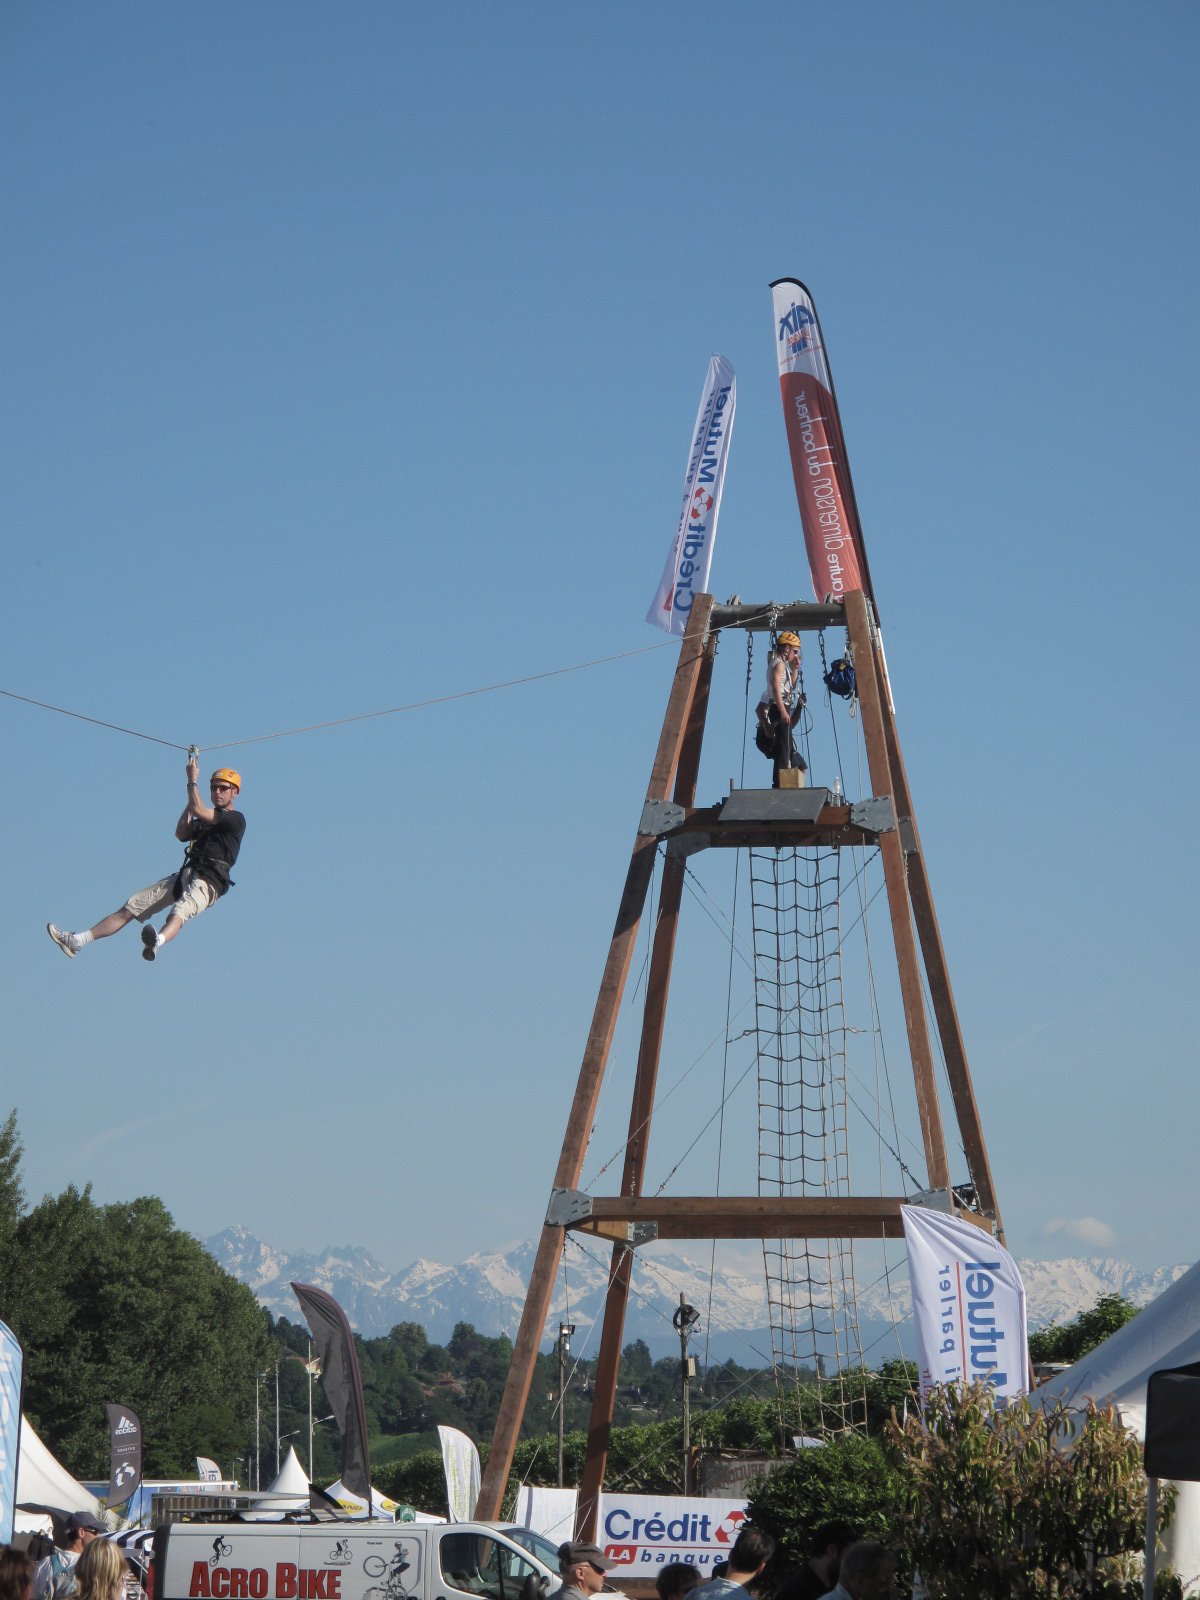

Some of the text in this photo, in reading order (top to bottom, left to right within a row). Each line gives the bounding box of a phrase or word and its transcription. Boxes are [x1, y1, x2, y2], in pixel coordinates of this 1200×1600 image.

[604, 1509, 711, 1542] Crédit
[608, 1548, 724, 1566] LA banque
[189, 1561, 342, 1599] ACRO BIKE
